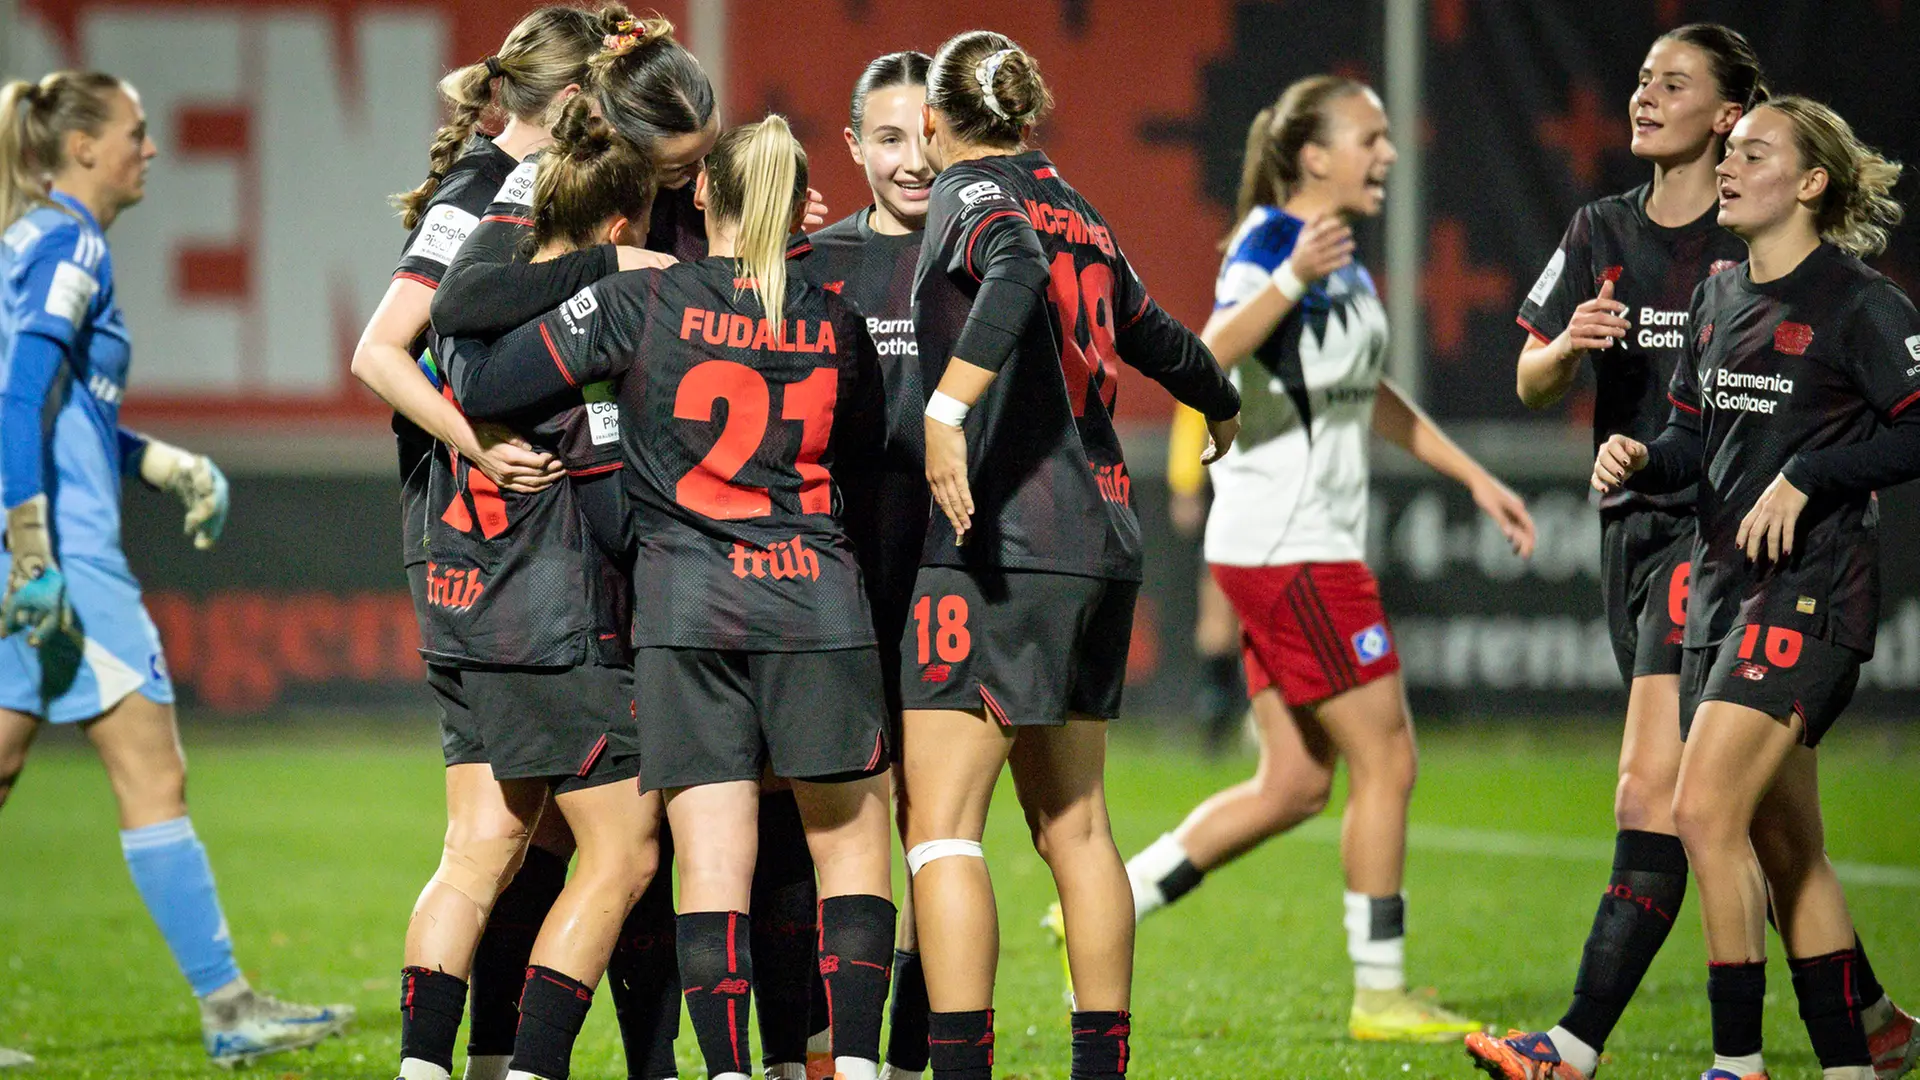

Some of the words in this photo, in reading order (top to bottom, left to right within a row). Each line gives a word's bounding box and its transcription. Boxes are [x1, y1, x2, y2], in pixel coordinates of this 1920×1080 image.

[12, 12, 447, 390] EN
[430, 222, 467, 242] oogle
[866, 317, 915, 334] Barm
[1639, 307, 1690, 326] Barm
[680, 306, 838, 355] FUDALLA
[1637, 329, 1684, 348] Goth
[873, 337, 919, 356] otha
[1717, 368, 1794, 395] Barmenia
[1715, 391, 1778, 415] Gothaer
[672, 359, 839, 521] 21
[913, 594, 971, 665] 18
